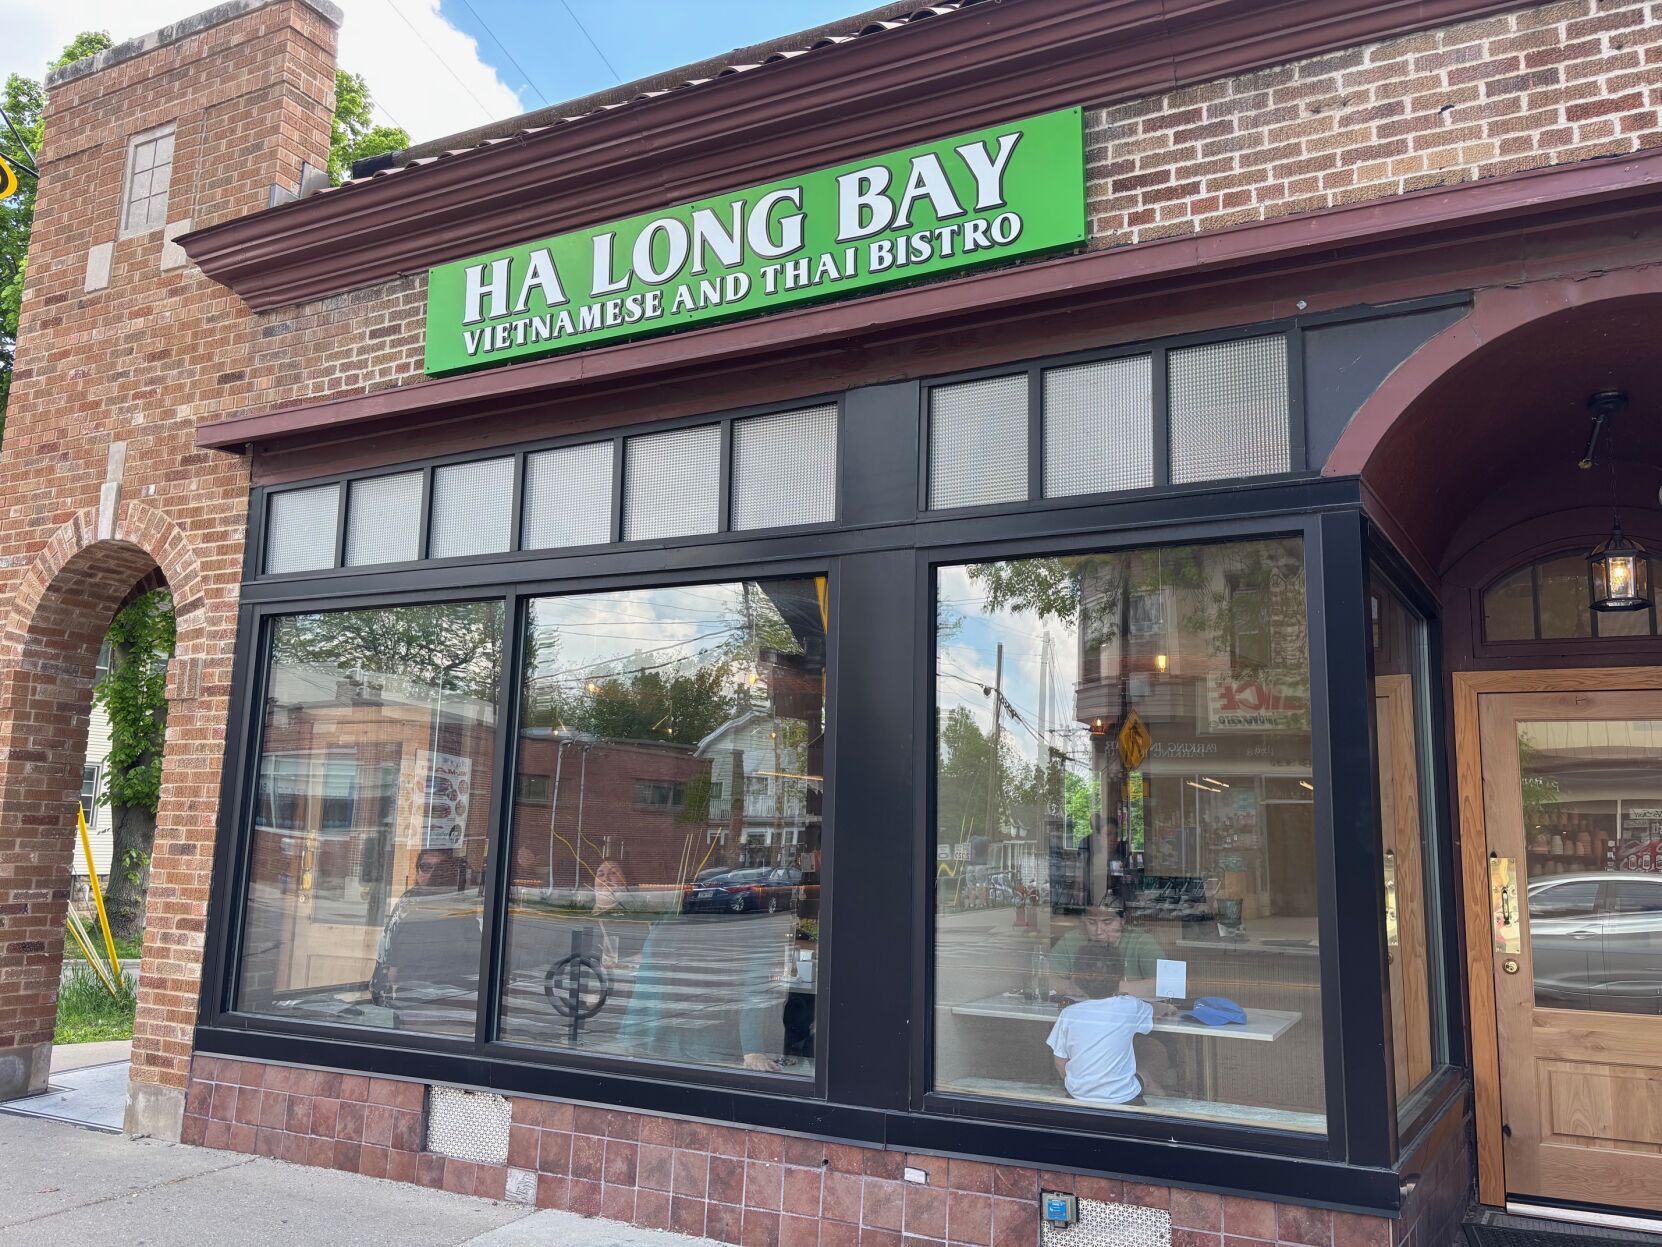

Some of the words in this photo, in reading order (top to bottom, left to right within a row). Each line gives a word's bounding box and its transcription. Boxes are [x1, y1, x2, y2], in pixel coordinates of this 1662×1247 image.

[462, 256, 570, 326] HA
[590, 186, 804, 298] LONG
[835, 130, 1024, 243] BAY
[463, 289, 663, 356] VIETNAMESE
[671, 271, 751, 315] AND
[760, 246, 859, 295] THAI
[868, 212, 1024, 274] BISTRO
